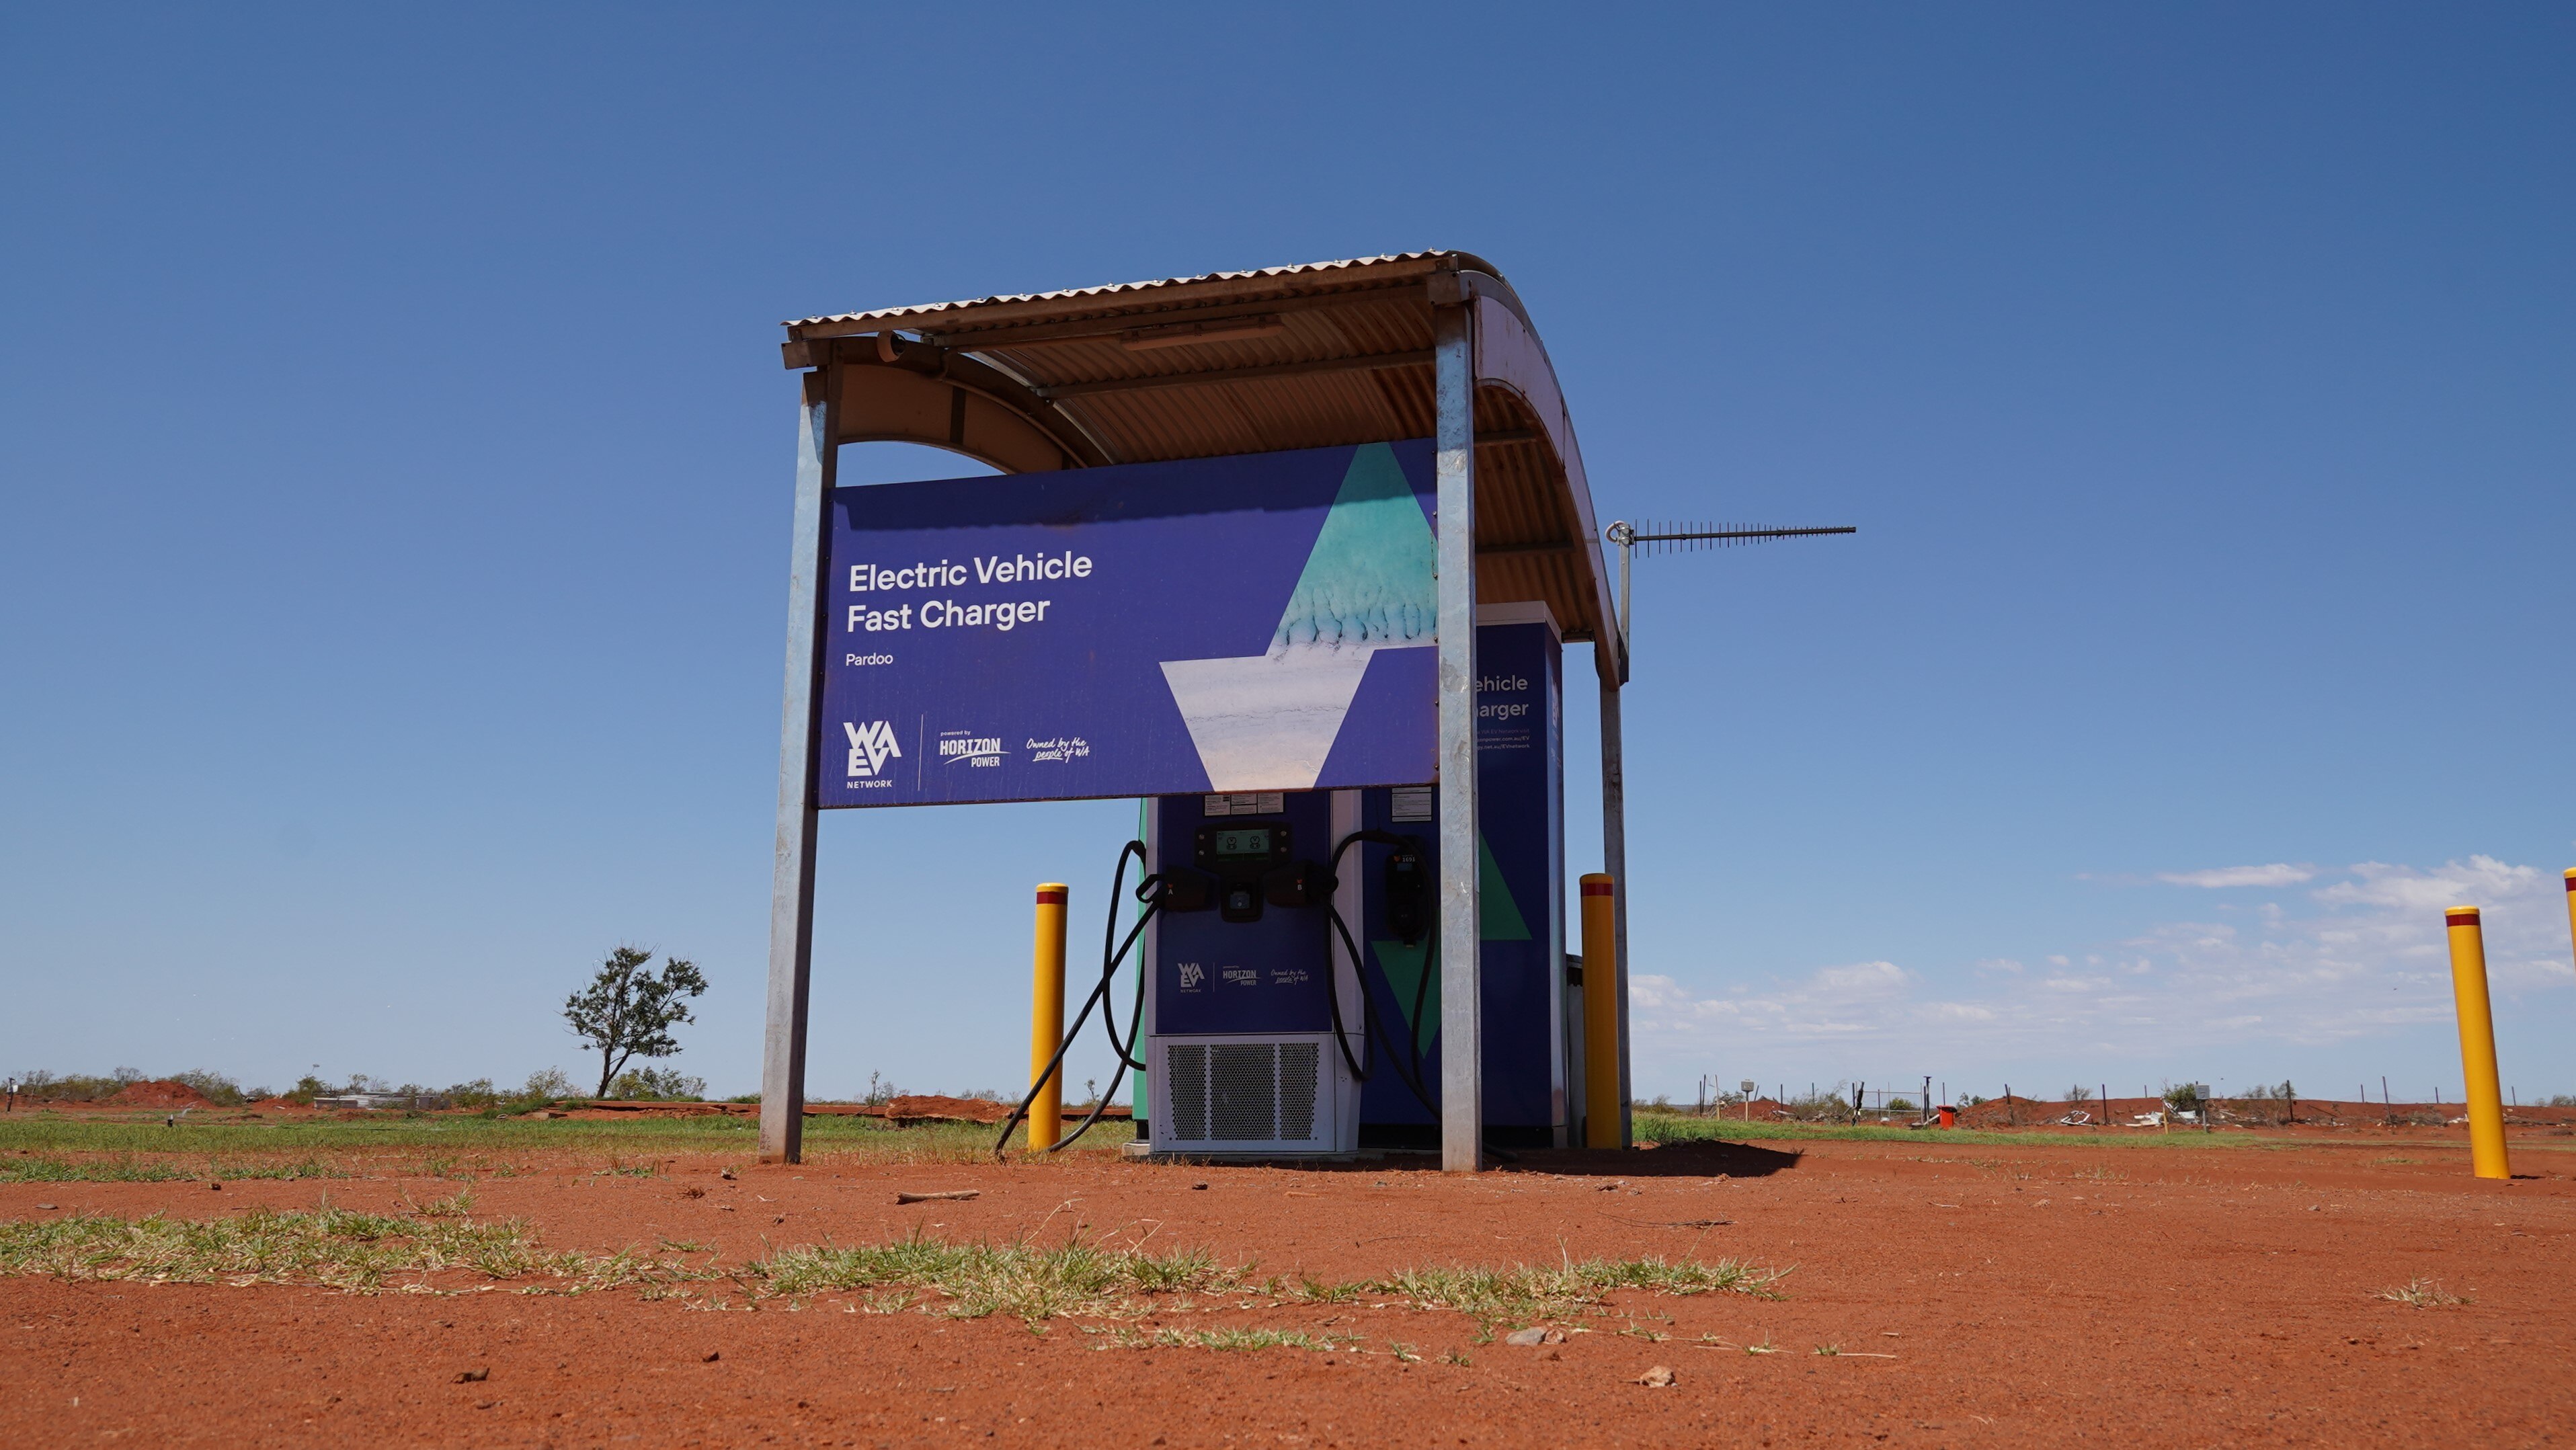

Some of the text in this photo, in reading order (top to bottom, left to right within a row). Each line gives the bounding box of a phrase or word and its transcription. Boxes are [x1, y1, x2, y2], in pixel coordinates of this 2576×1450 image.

[849, 551, 1092, 592] Electric Vehicle
[847, 600, 1050, 633] Fast Charger
[846, 653, 893, 666] Pardoo
[1476, 675, 1528, 692] ehicle
[1477, 703, 1529, 720] arger
[939, 737, 1001, 756] HORIZON
[1027, 737, 1087, 752] Owned by the
[971, 756, 1000, 768] POWER
[1033, 746, 1090, 764] people of WA
[846, 780, 893, 789] NETWORK
[1223, 969, 1256, 979] HORIZON
[1271, 968, 1288, 976] Owned
[1289, 968, 1297, 978] by
